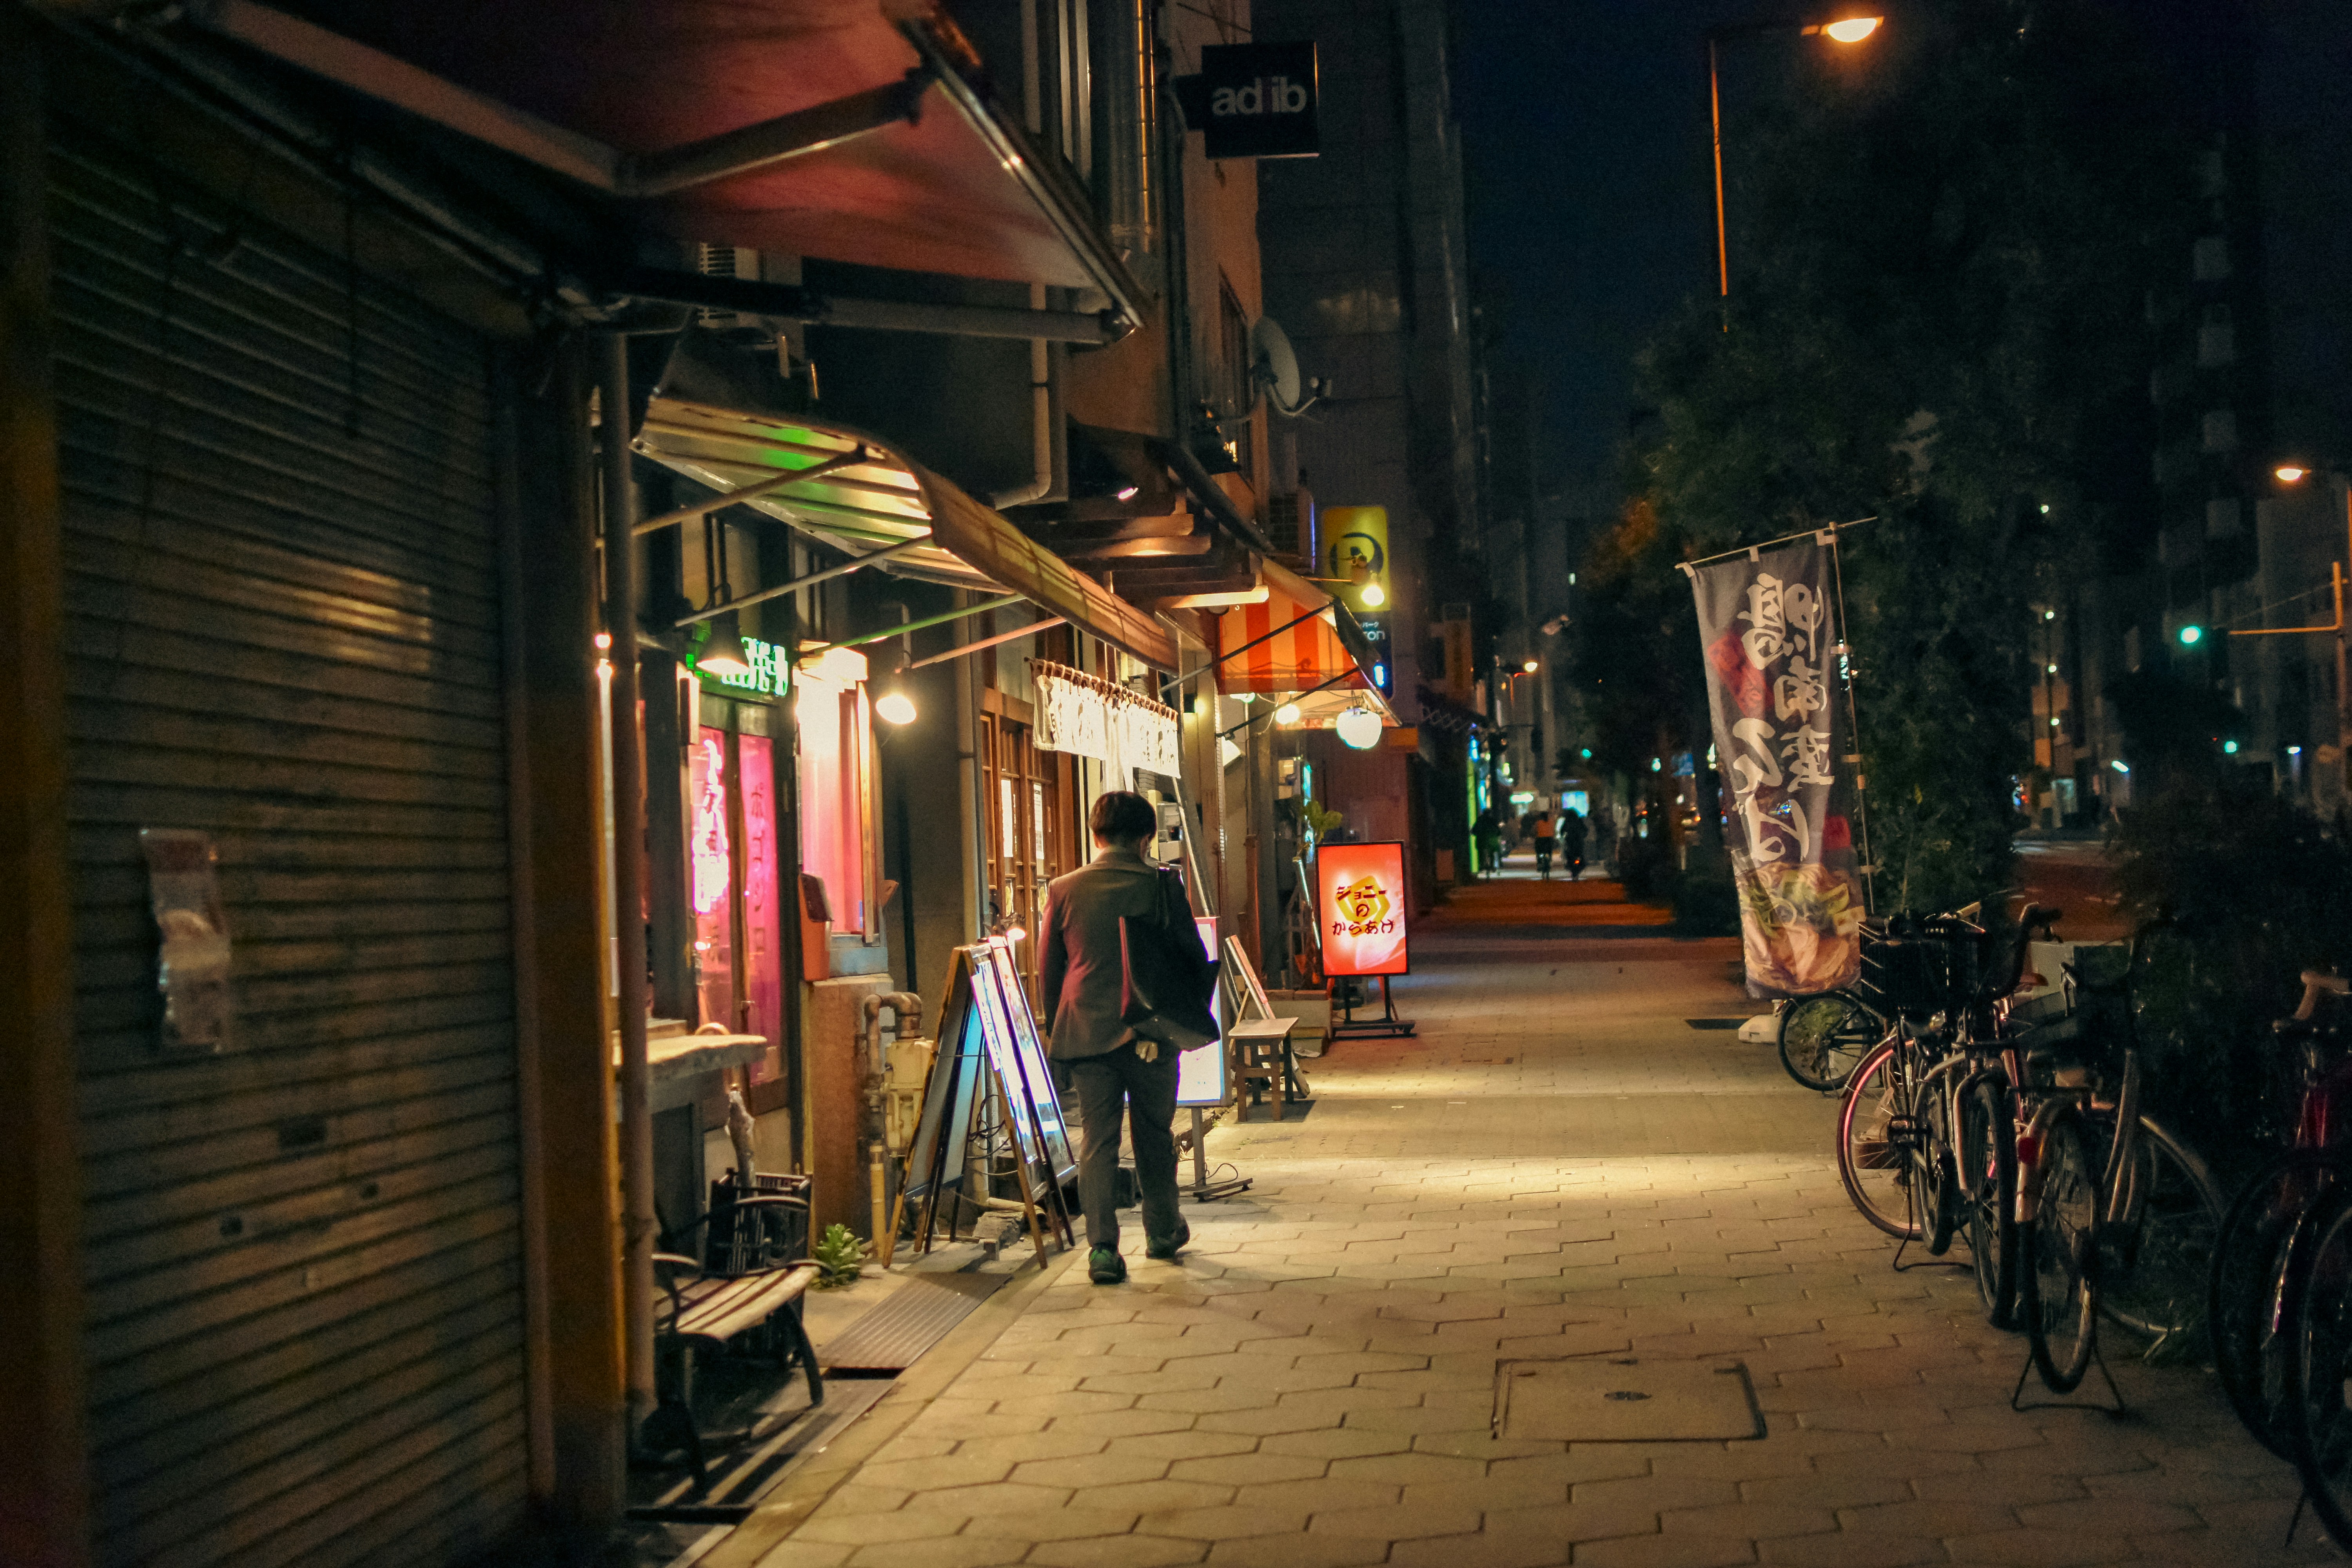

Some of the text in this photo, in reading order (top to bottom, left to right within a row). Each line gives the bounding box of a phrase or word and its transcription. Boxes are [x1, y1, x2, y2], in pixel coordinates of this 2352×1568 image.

[1212, 76, 1307, 116] adlib
[1336, 885, 1388, 901] ジョニー
[1356, 903, 1370, 917] の
